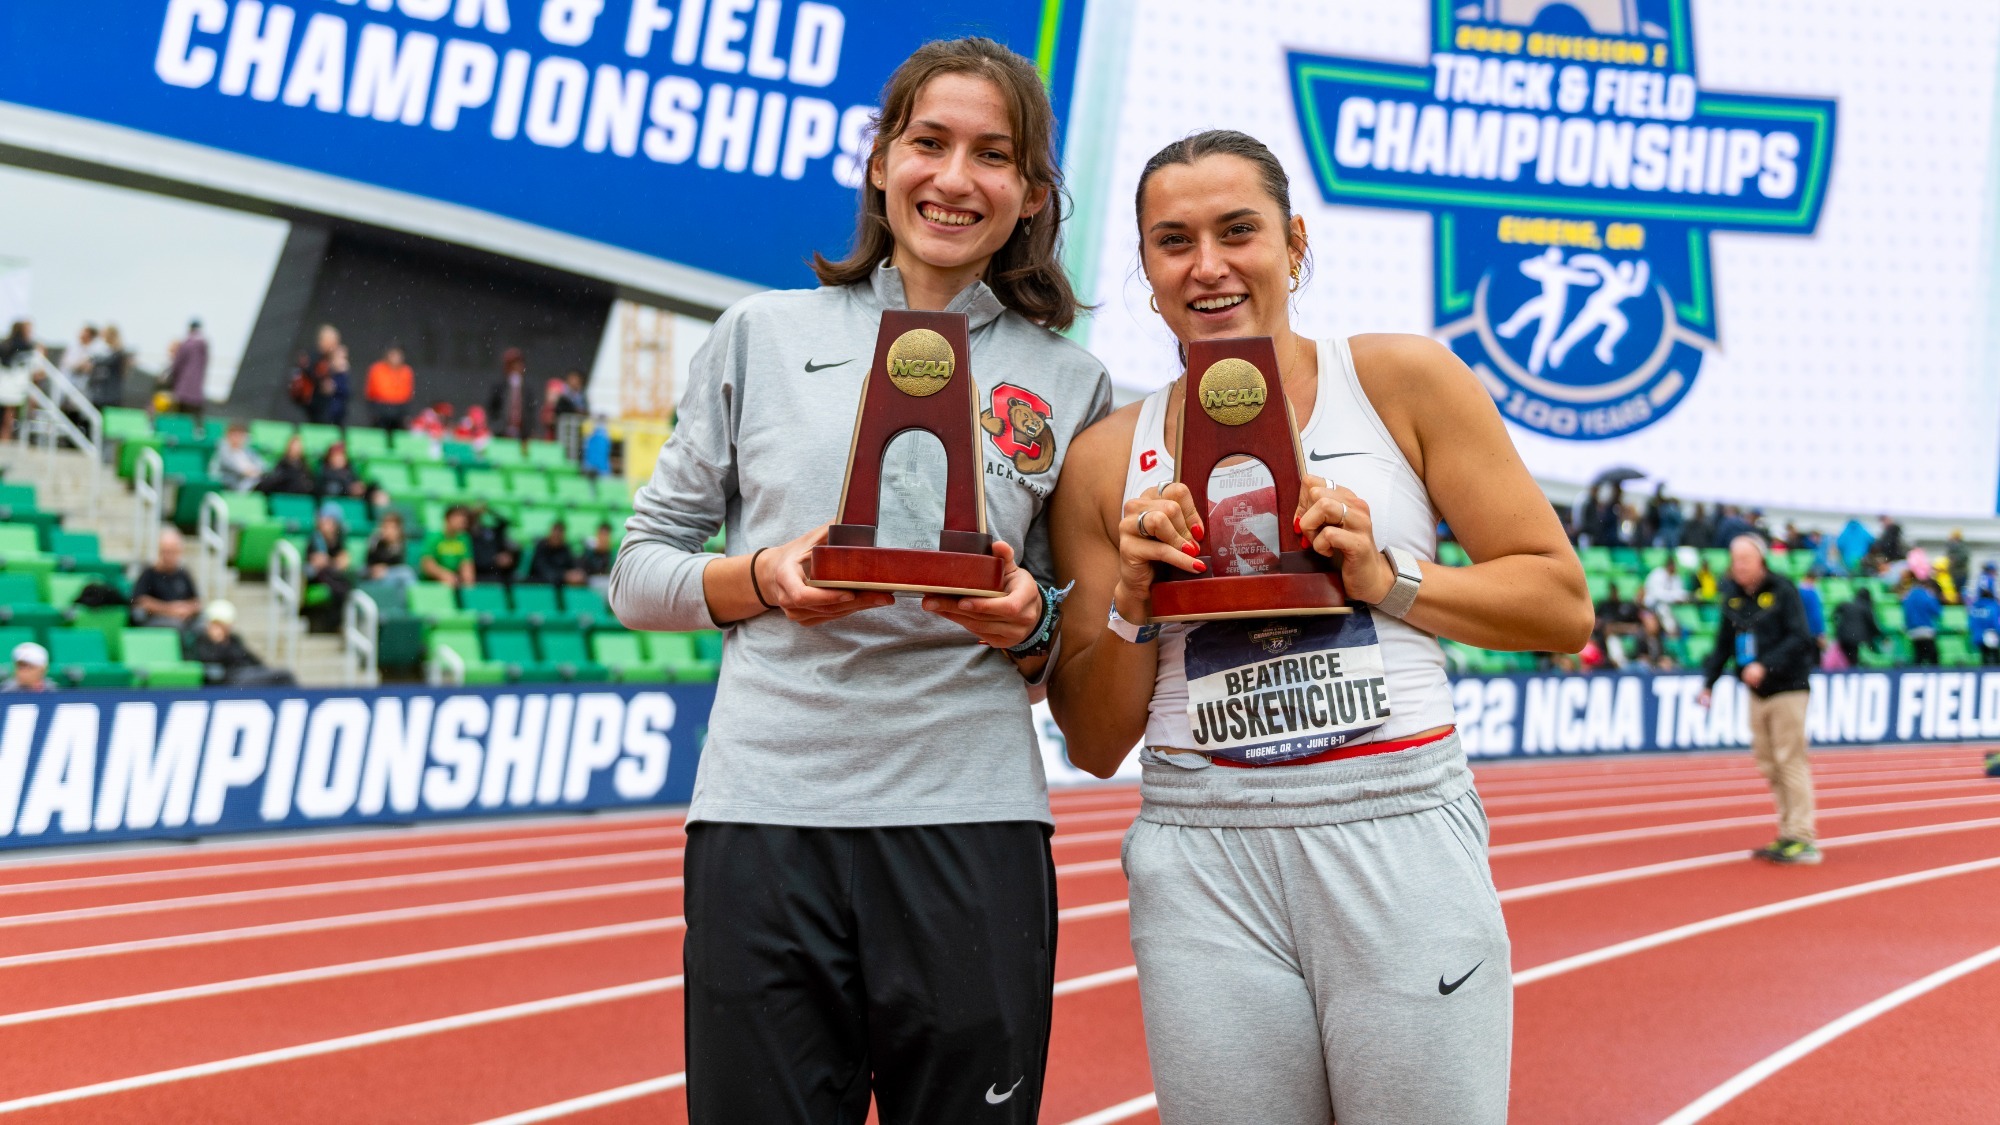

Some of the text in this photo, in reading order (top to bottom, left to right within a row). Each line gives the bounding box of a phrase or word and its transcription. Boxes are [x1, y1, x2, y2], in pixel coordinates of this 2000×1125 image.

[624, 0, 847, 88] FIELD
[1526, 32, 1648, 66] DIVISION
[153, 0, 881, 189] CHAMPIONSHIPS
[1433, 52, 1697, 122] TRACK & FIELD
[1333, 96, 1800, 200] CHAMPIONSHIPS
[1497, 215, 1645, 251] EUGENE, OR
[891, 358, 950, 379] NCAA
[1206, 387, 1265, 409] NCAA
[1504, 390, 1652, 437] 100 YEARS
[986, 461, 1014, 480] ACK
[1139, 449, 1158, 473] C
[1219, 477, 1259, 489] DIVISION
[1229, 557, 1265, 567] HEATHLON
[1256, 545, 1270, 554] FIEL
[1224, 652, 1343, 697] BEATRICE
[1192, 676, 1391, 746] JUSKEVICIUTE
[1449, 671, 2000, 755] 22 NCAA TRA AND FIELD
[1245, 734, 1346, 759] EUGENE, OR JUNE 8-11
